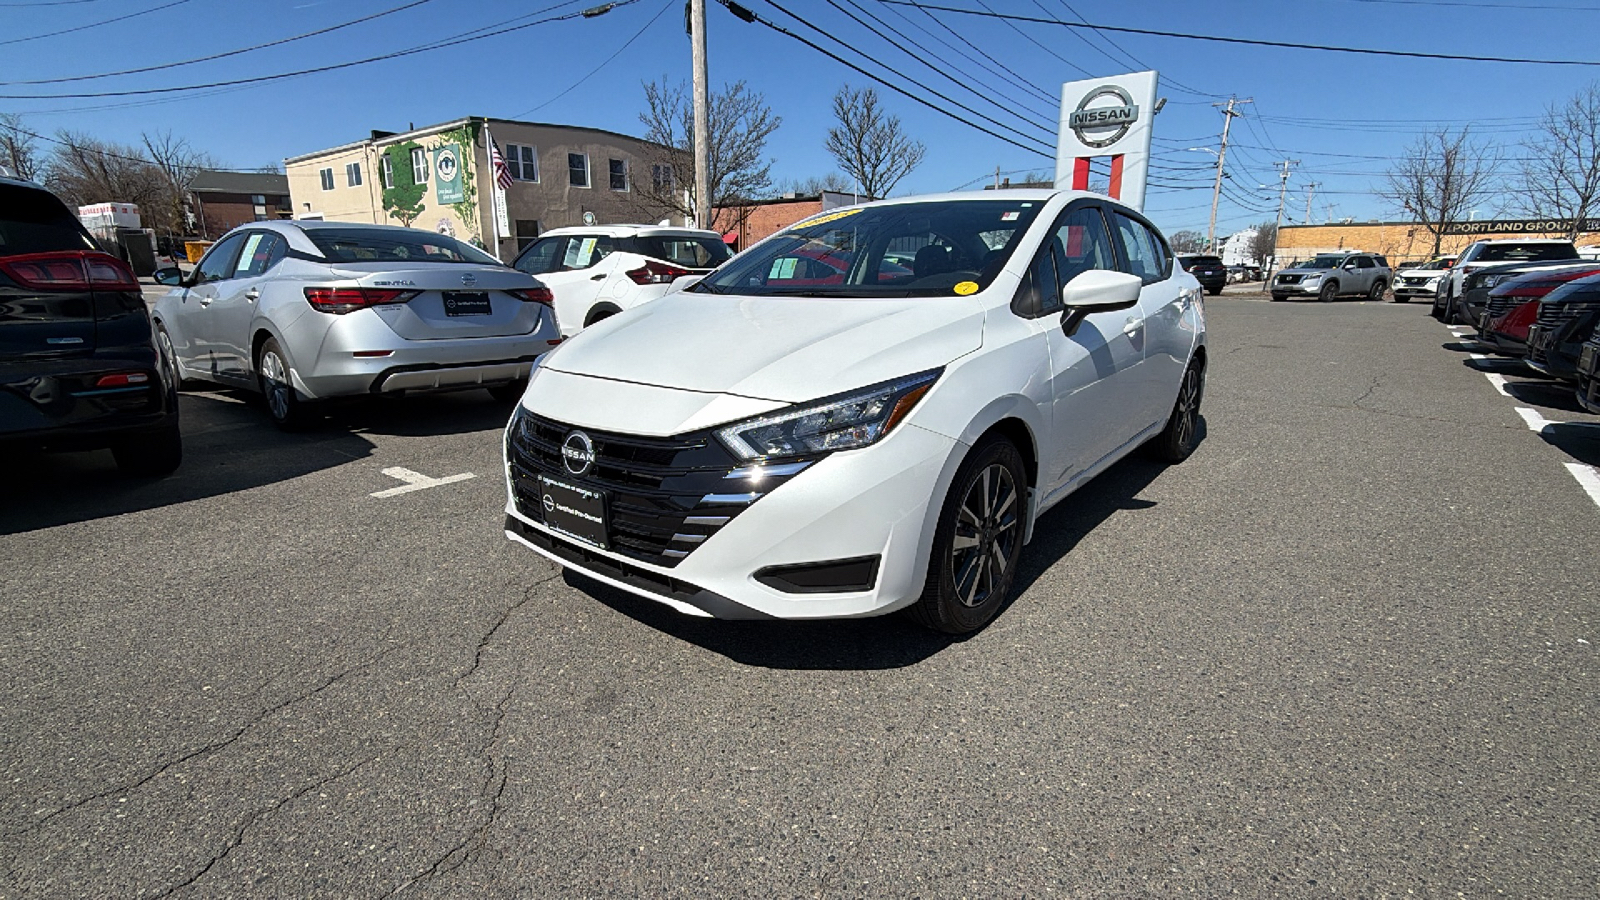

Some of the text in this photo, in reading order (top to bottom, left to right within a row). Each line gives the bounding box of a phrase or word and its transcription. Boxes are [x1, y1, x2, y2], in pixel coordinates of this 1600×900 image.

[1074, 108, 1131, 123] NISSAN
[1452, 222, 1523, 232] PORTLAND
[556, 503, 602, 523] Certified Pre-Owned
